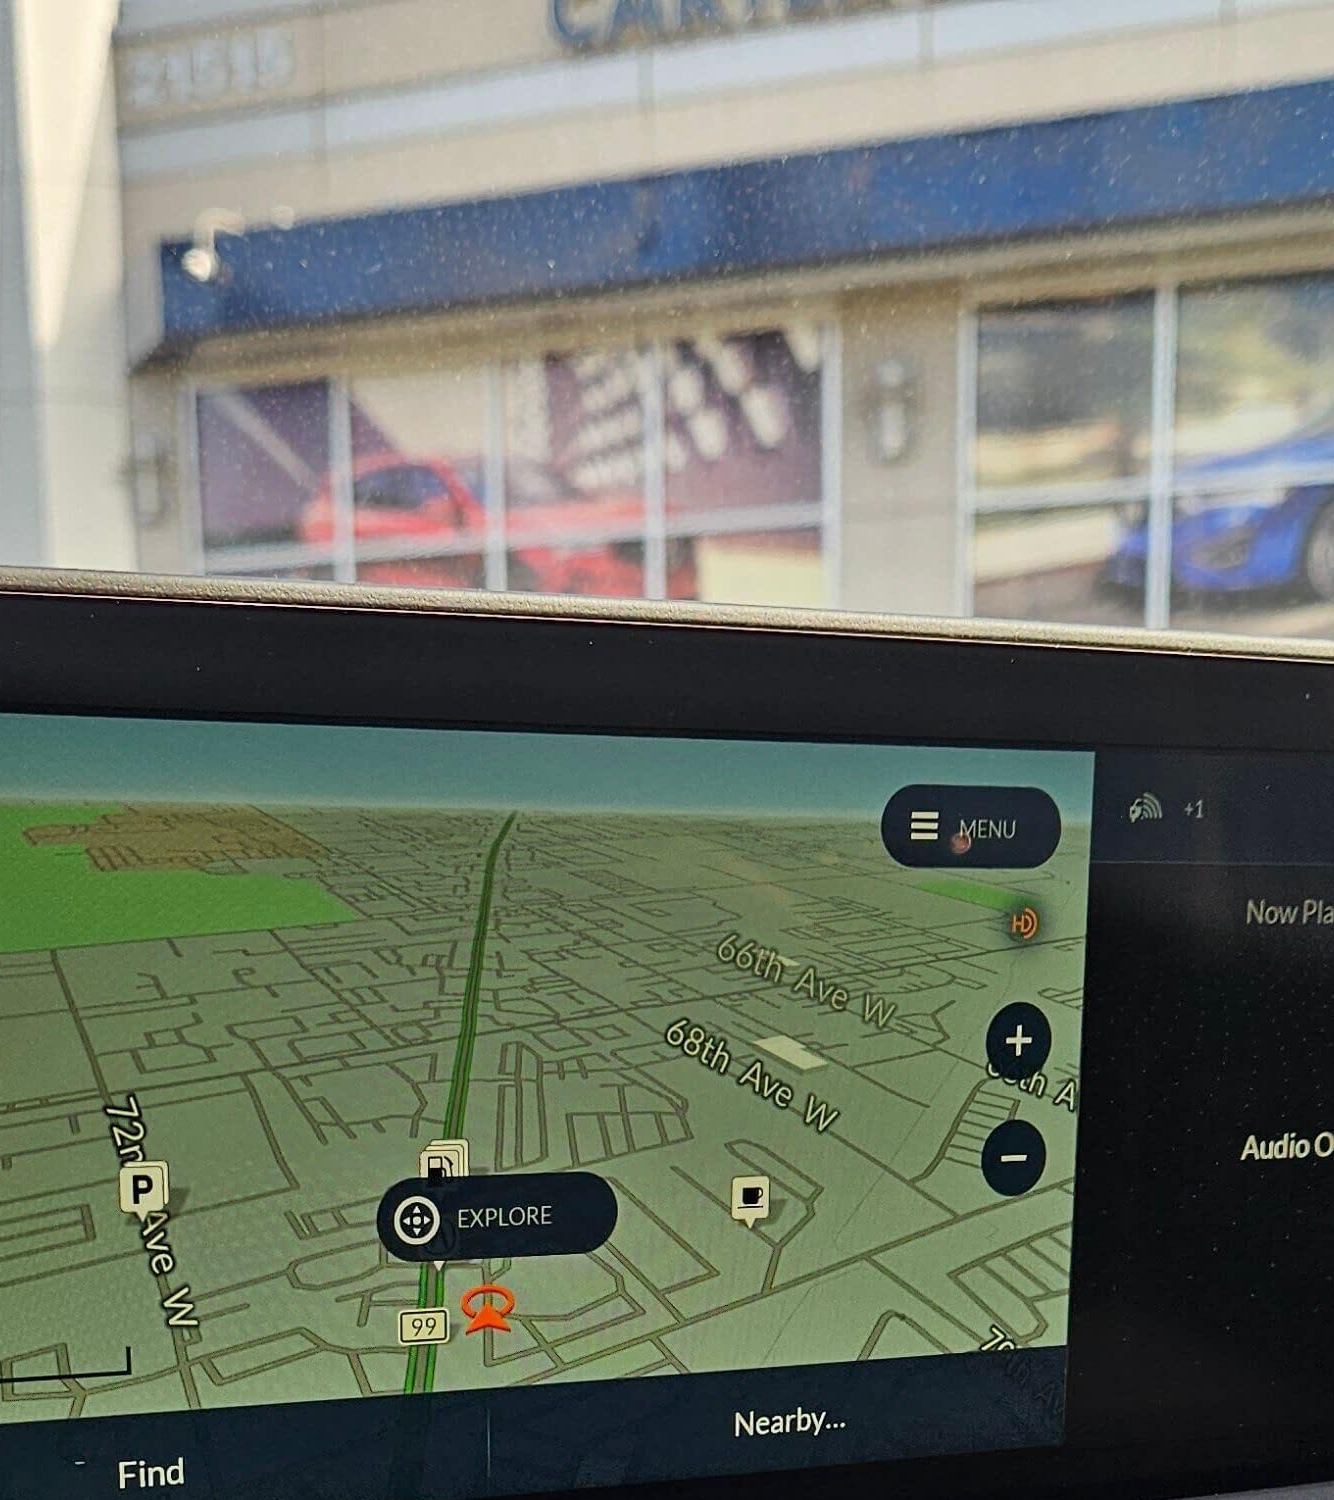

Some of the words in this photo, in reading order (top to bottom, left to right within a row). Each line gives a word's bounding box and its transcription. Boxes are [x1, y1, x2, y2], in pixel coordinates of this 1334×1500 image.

[960, 819, 1016, 839] MENU
[1246, 899, 1298, 925] Now
[717, 934, 783, 983] 66th
[794, 968, 848, 1010] Ave
[863, 994, 895, 1028] W
[666, 1019, 731, 1074] 68th
[739, 1062, 793, 1108] Ave
[804, 1095, 838, 1132] W
[1240, 1132, 1310, 1161] Audio
[457, 1205, 553, 1229] EXPLORE
[142, 1211, 175, 1275] Ave
[164, 1288, 198, 1326] W
[411, 1317, 437, 1337] 99
[734, 1407, 846, 1437] Nearby...
[118, 1457, 185, 1489] Find
